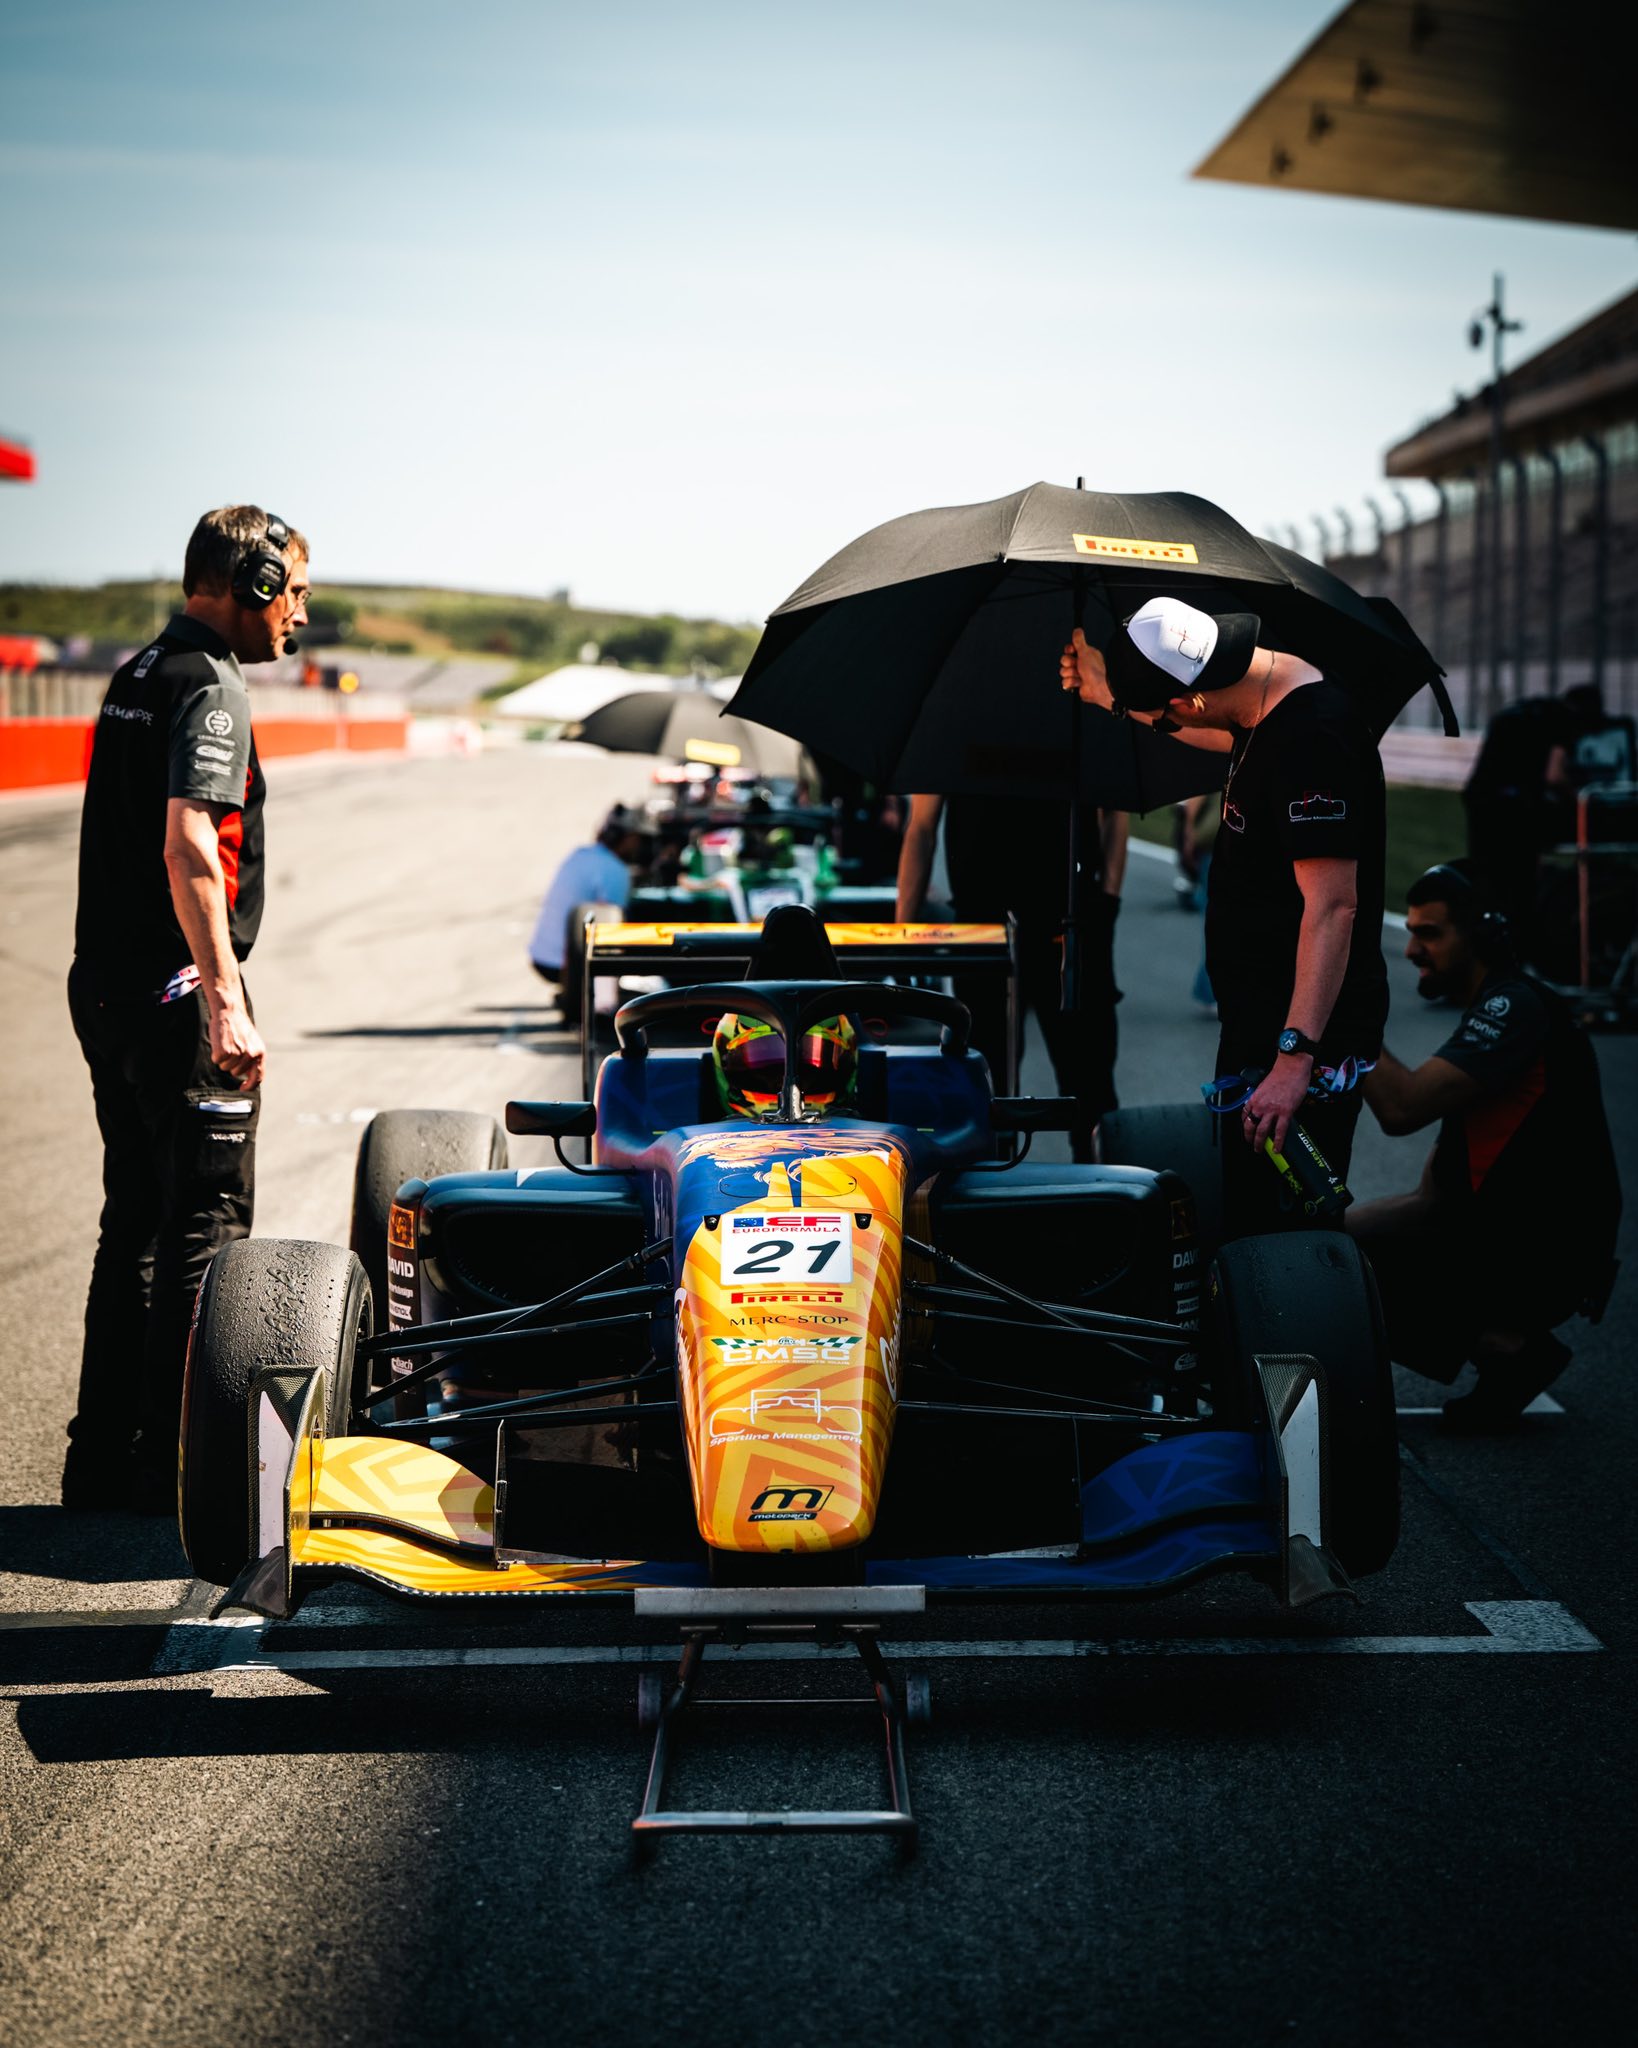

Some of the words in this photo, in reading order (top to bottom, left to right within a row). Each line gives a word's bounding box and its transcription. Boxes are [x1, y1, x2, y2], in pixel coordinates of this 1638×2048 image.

[1085, 539, 1185, 559] PIRELLI
[732, 1226, 842, 1234] EUROFORMULA
[733, 1239, 842, 1275] 21
[731, 1291, 844, 1304] PIRELLI
[730, 1315, 849, 1327] MERC-STOP
[723, 1347, 850, 1362] CMSC
[710, 1432, 770, 1447] Sportline
[772, 1431, 863, 1445] Management
